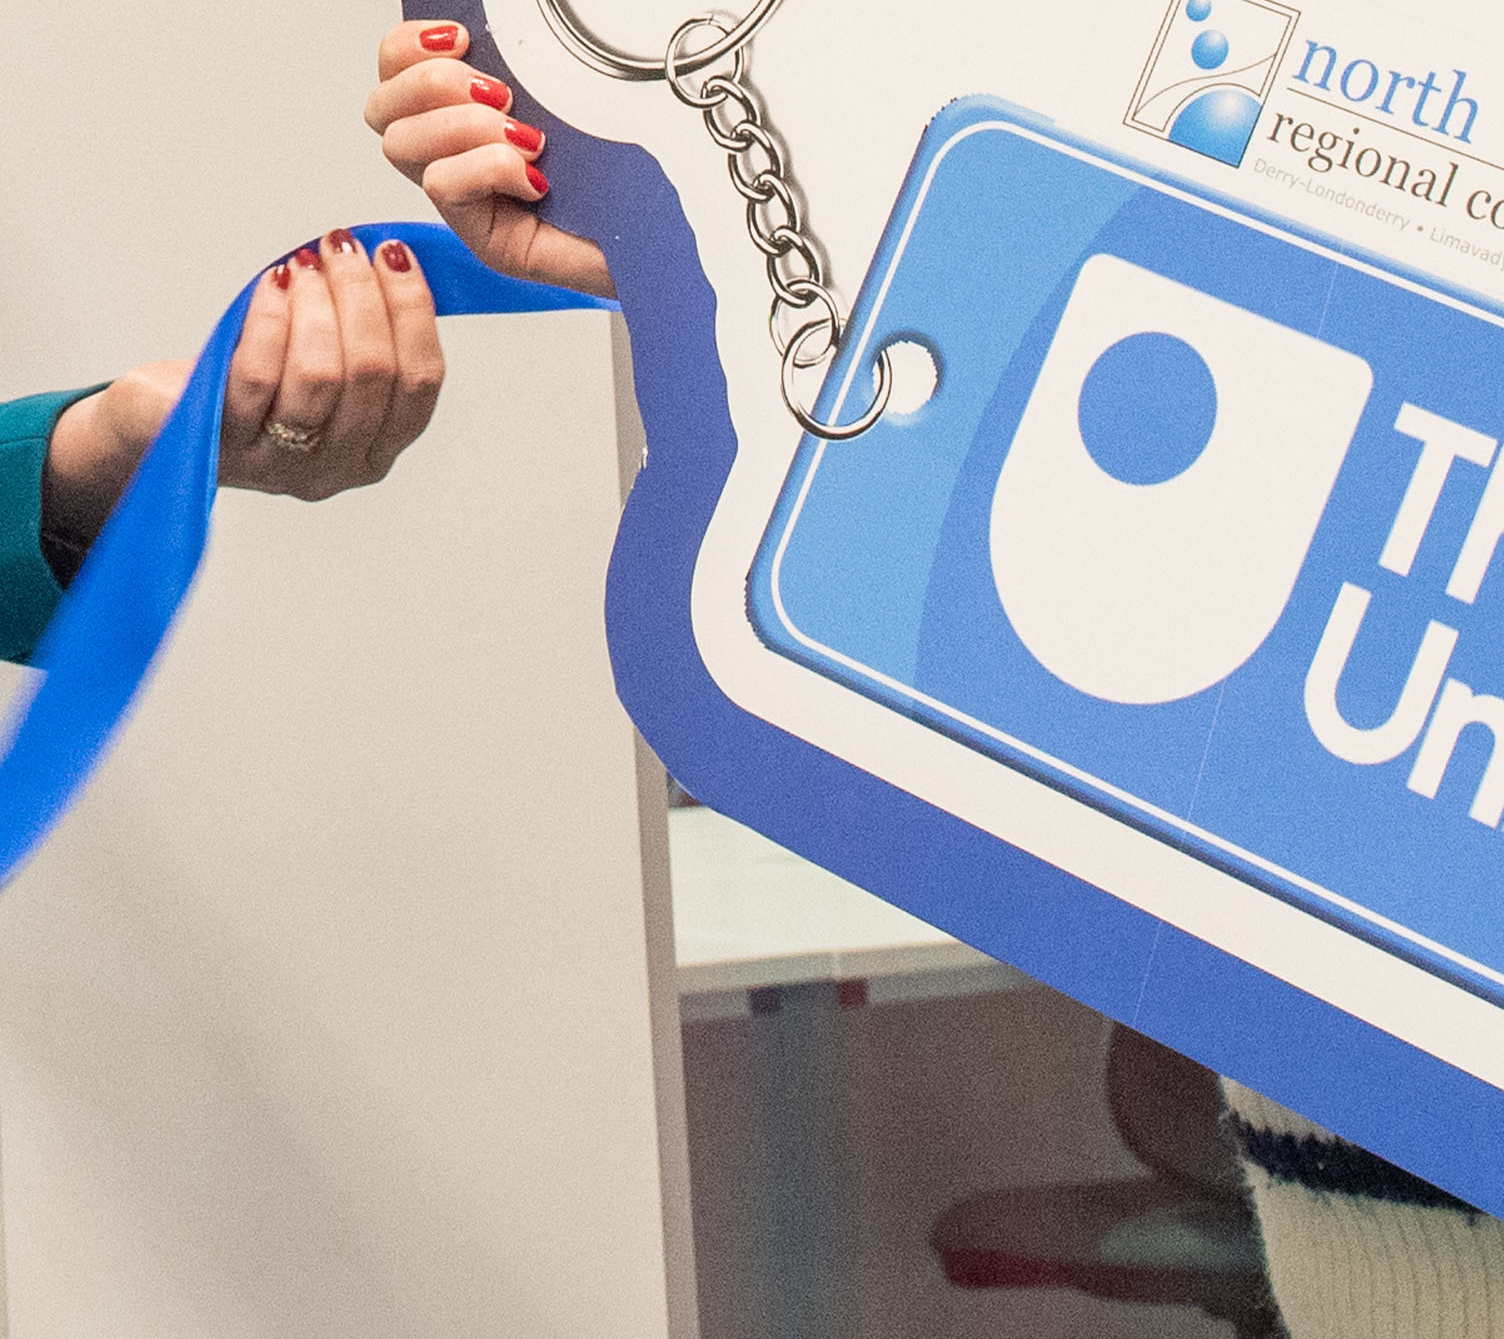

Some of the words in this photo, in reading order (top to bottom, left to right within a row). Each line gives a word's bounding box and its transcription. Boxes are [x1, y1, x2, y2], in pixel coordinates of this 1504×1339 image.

[1292, 38, 1480, 145] north
[1253, 157, 1412, 232] Derry-Londonderry
[1268, 111, 1460, 208] regional
